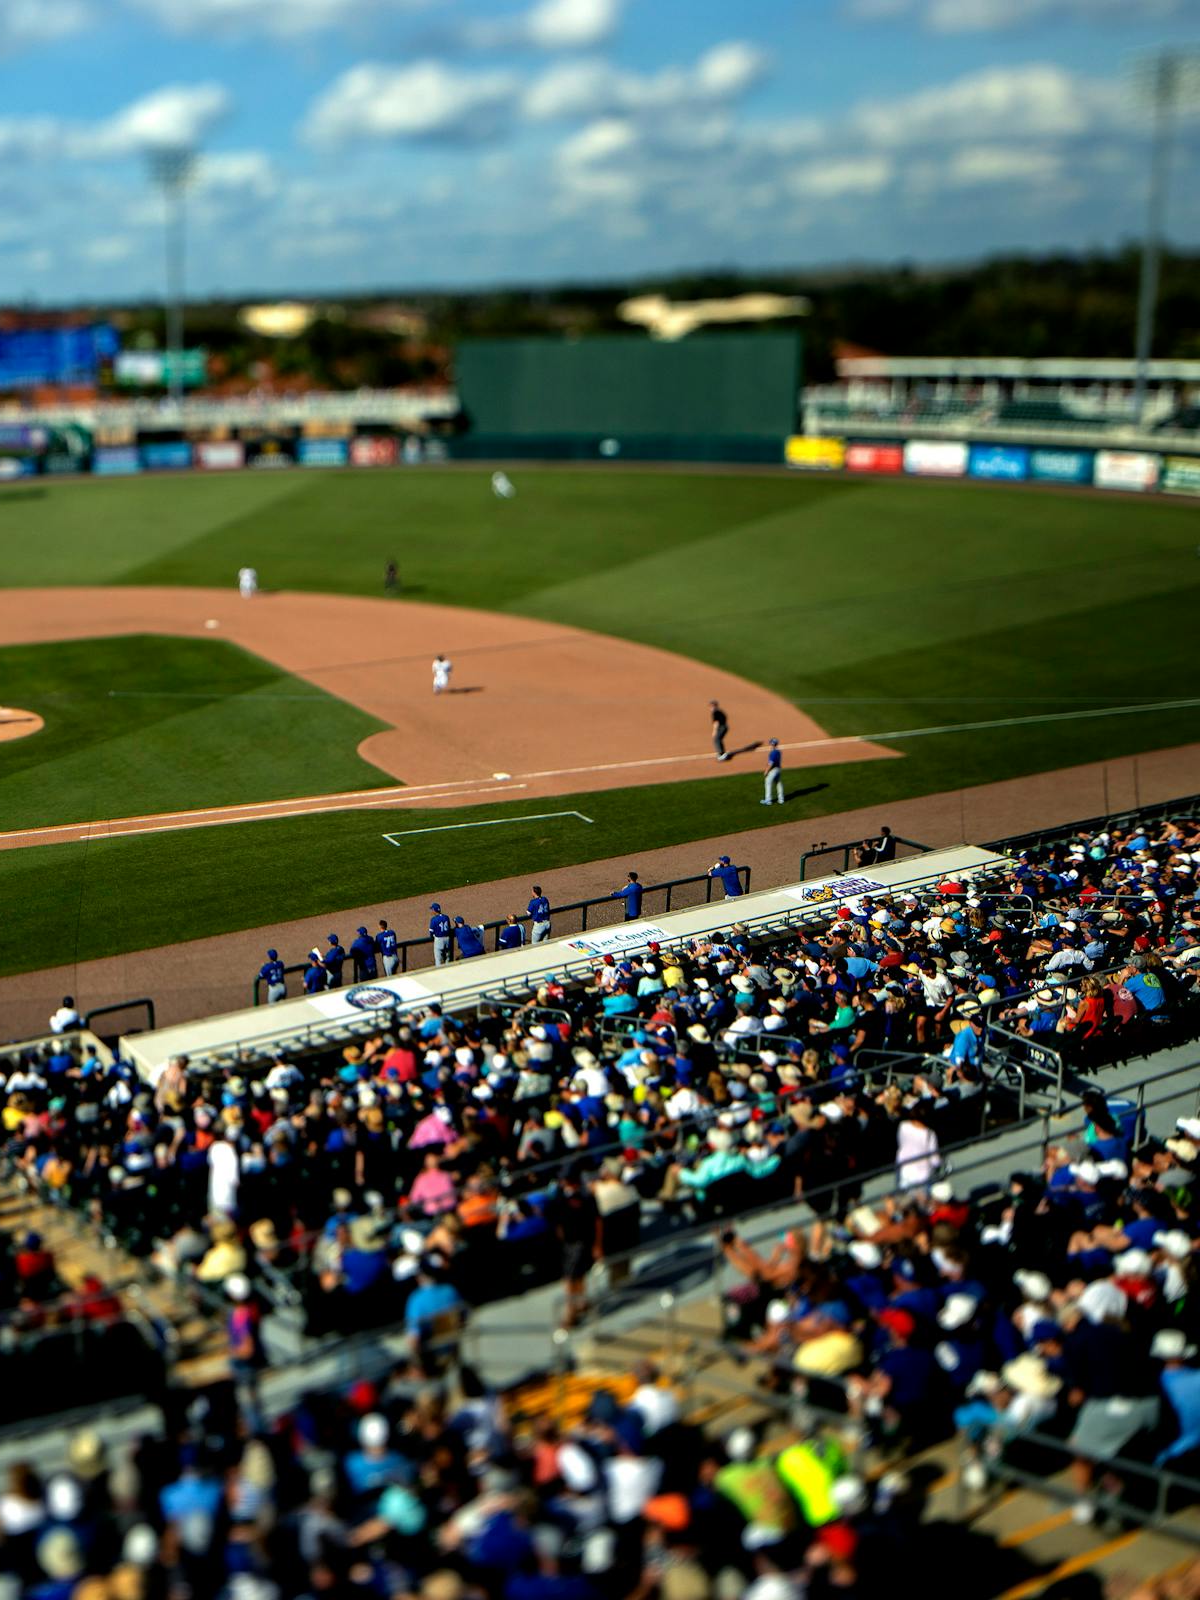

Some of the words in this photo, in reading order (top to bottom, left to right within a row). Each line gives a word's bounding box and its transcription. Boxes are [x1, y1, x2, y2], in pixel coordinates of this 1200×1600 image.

[590, 939, 614, 948] Lee
[614, 927, 665, 943] County
[1030, 1048, 1045, 1063] 103
